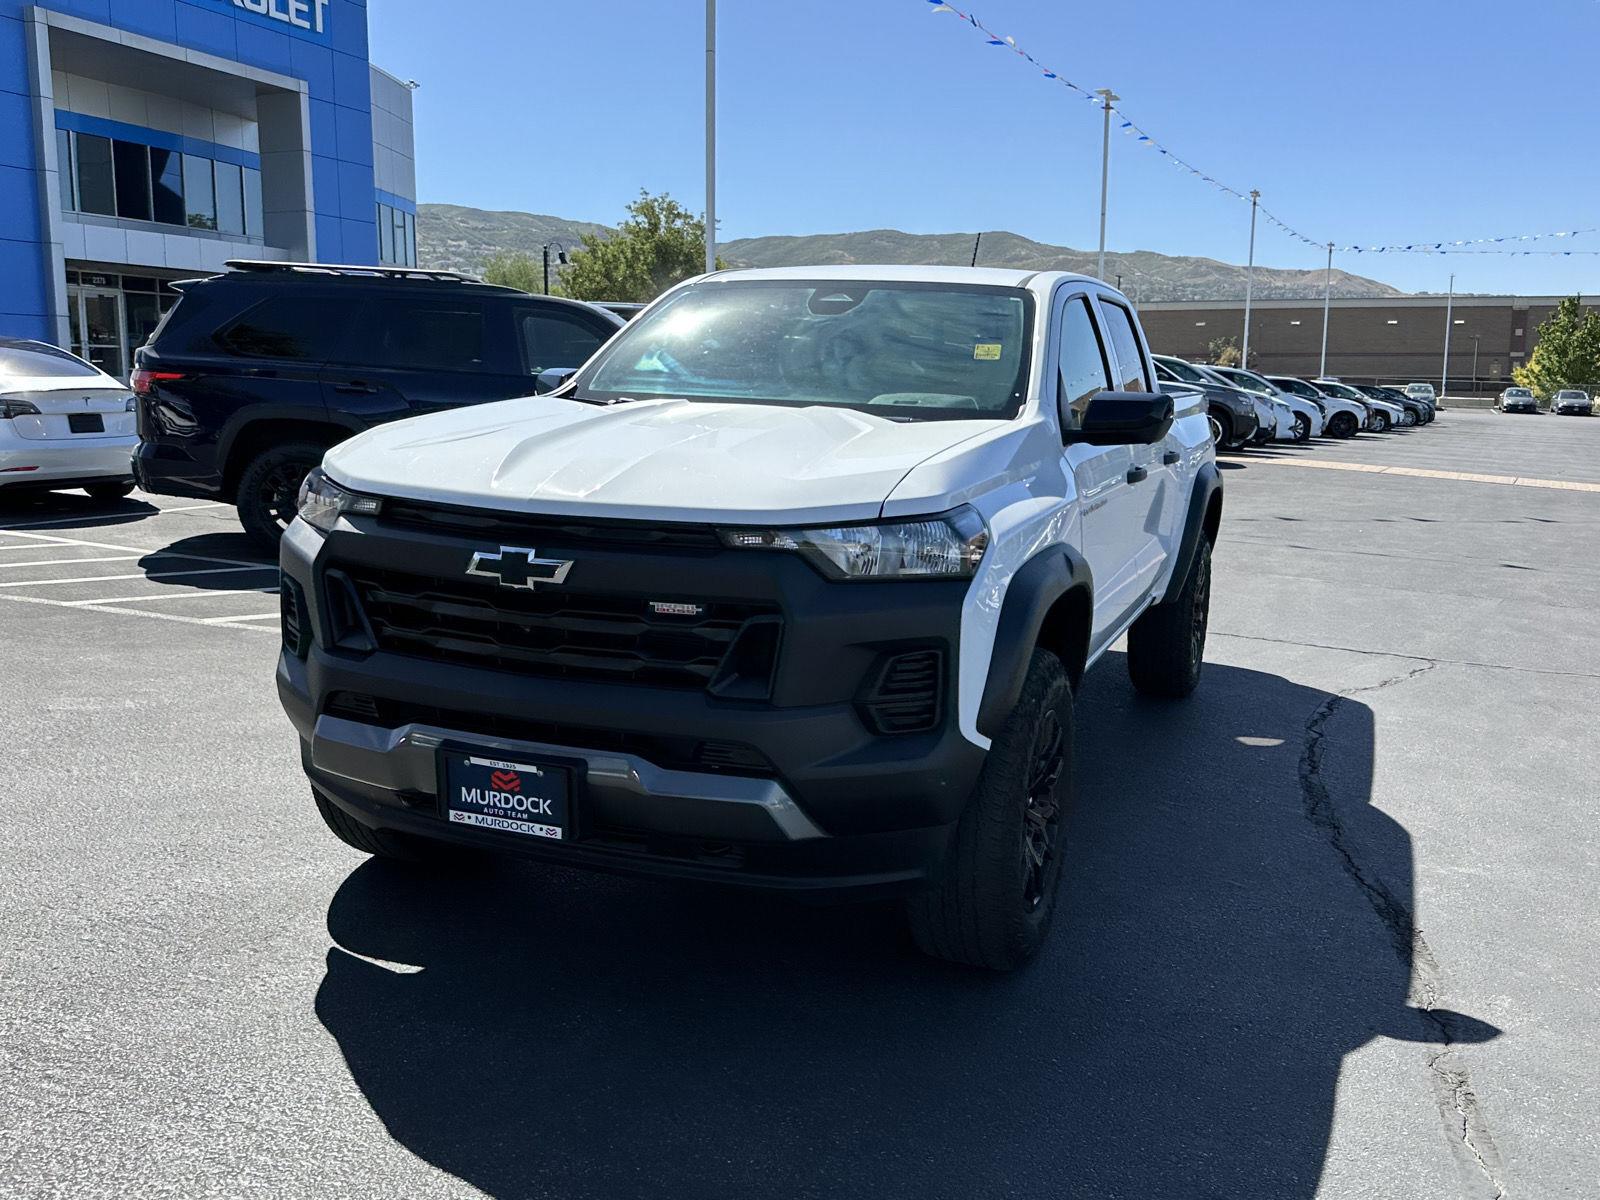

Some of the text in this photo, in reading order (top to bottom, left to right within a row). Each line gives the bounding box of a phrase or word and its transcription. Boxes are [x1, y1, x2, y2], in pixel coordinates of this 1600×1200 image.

[461, 786, 553, 815] MURDOCK
[483, 807, 528, 819] AUTO TEAM
[474, 815, 536, 833] MURDOCK
